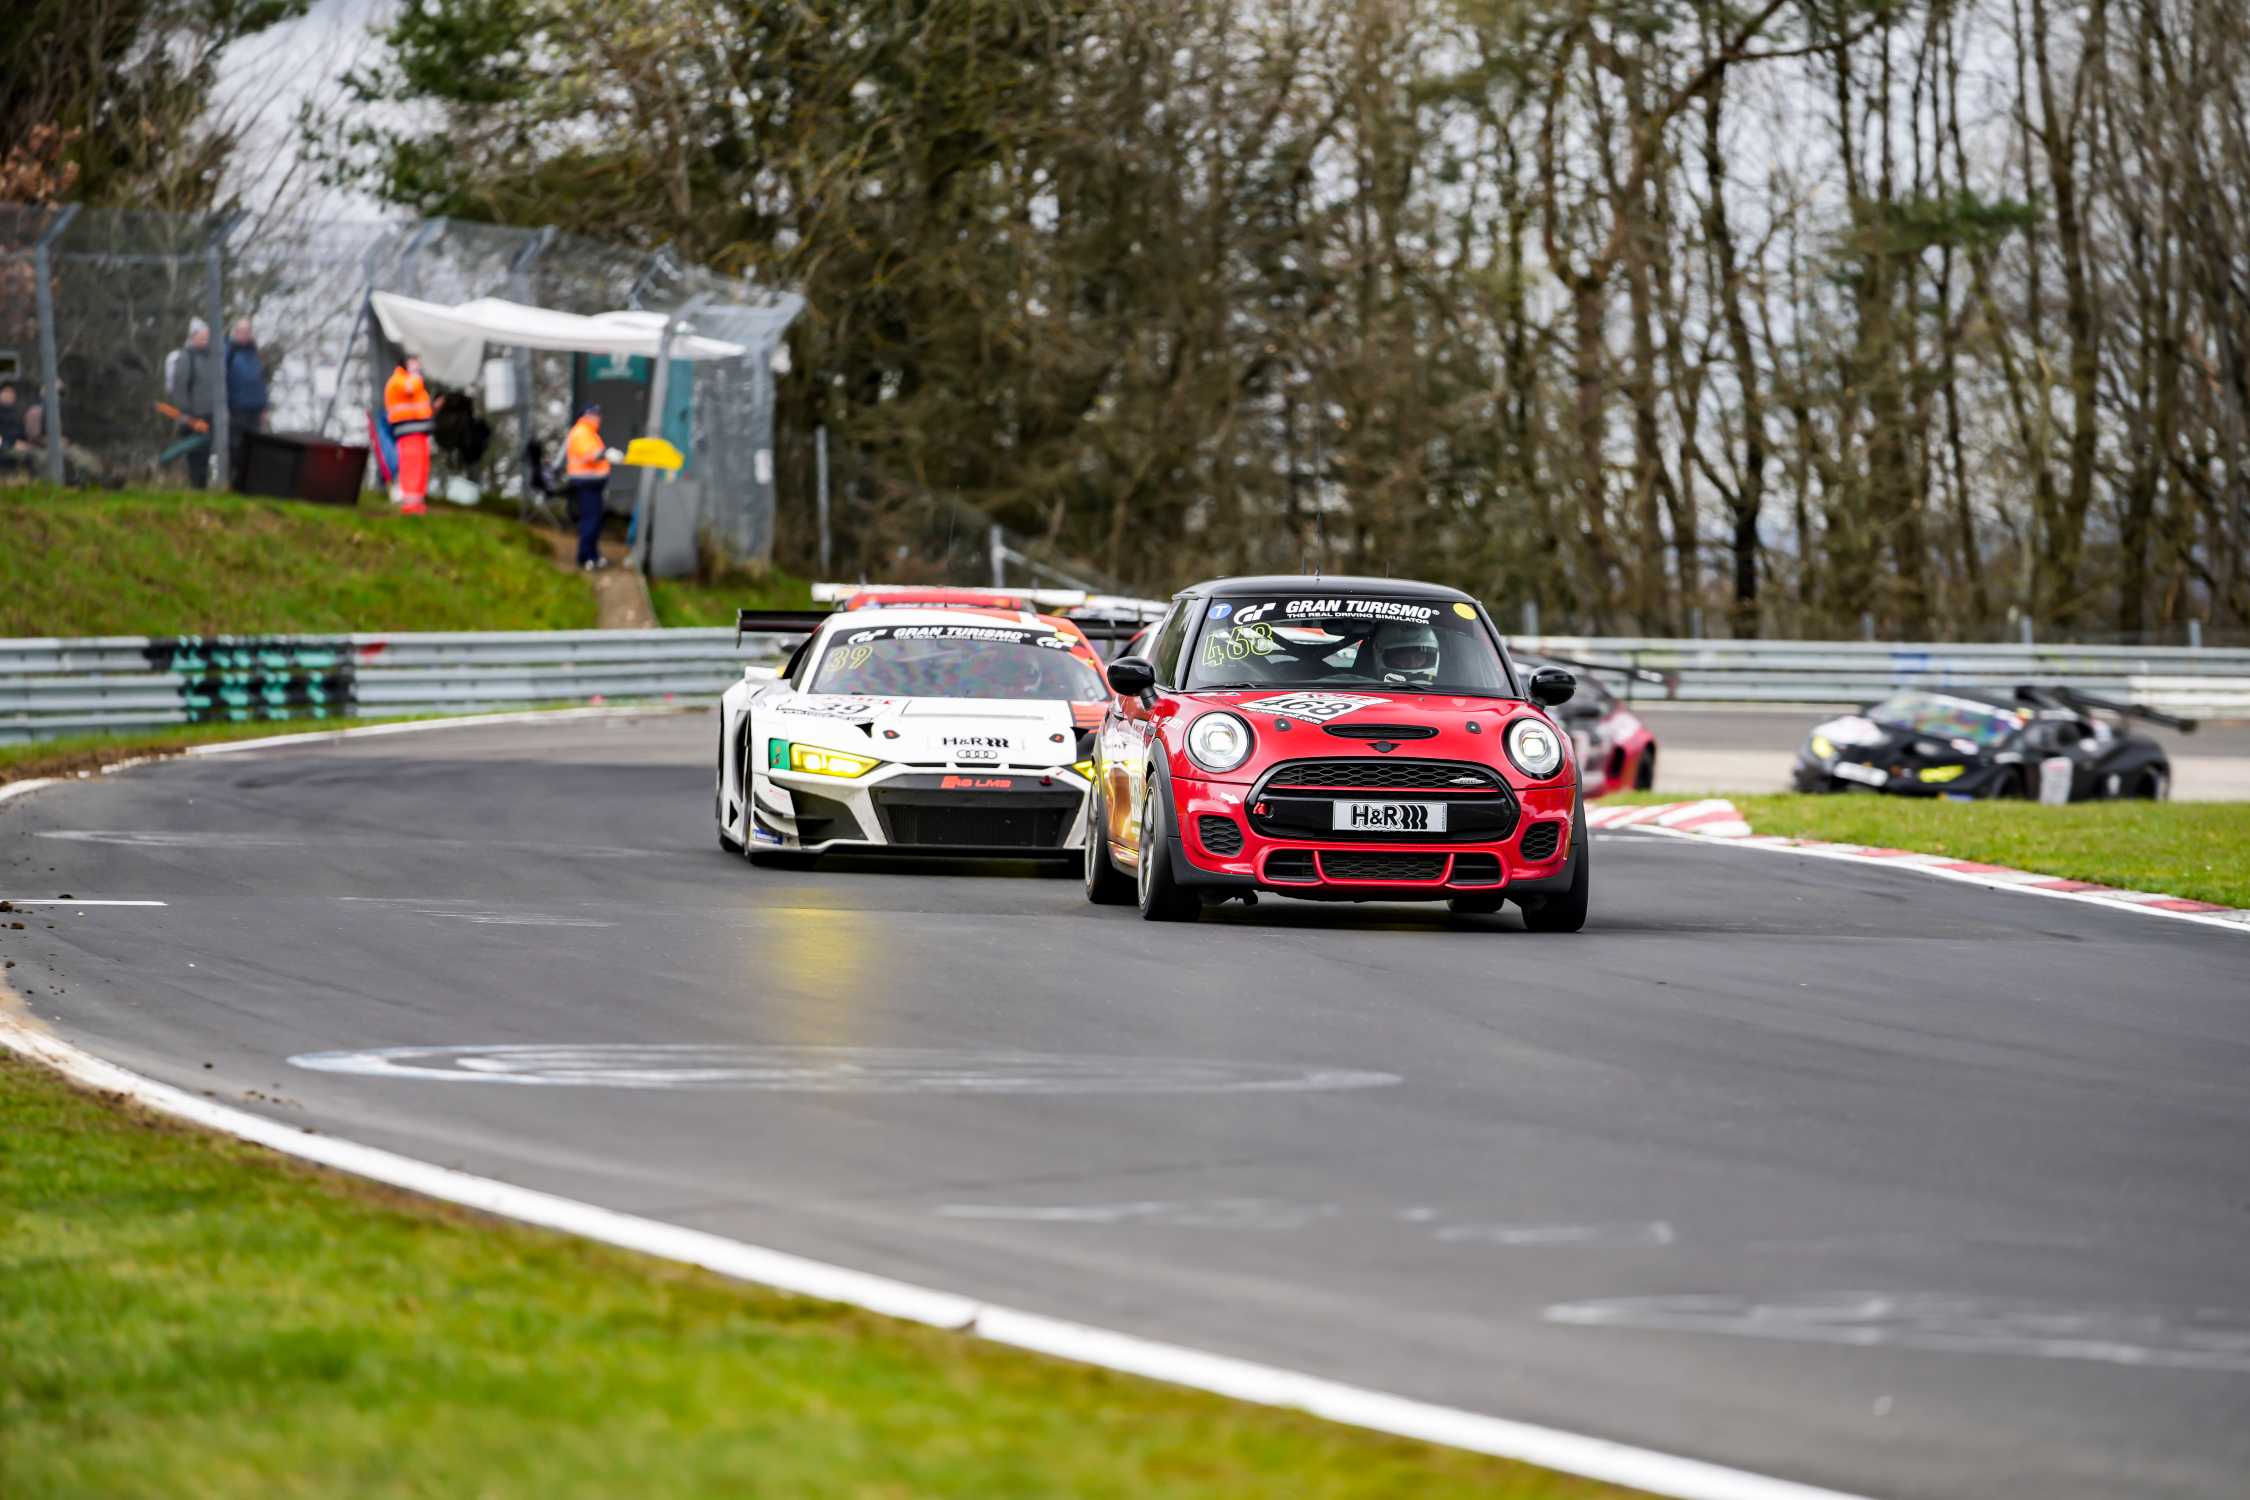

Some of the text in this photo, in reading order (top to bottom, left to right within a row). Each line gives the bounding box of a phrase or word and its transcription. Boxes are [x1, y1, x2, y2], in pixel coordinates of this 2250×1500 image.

[1285, 599, 1342, 614] GRAN
[1375, 614, 1430, 625] SIMULATOR
[892, 626, 943, 638] GRAN
[1202, 621, 1273, 666] 468
[1254, 698, 1353, 716] 468
[1351, 803, 1400, 829] H&R
